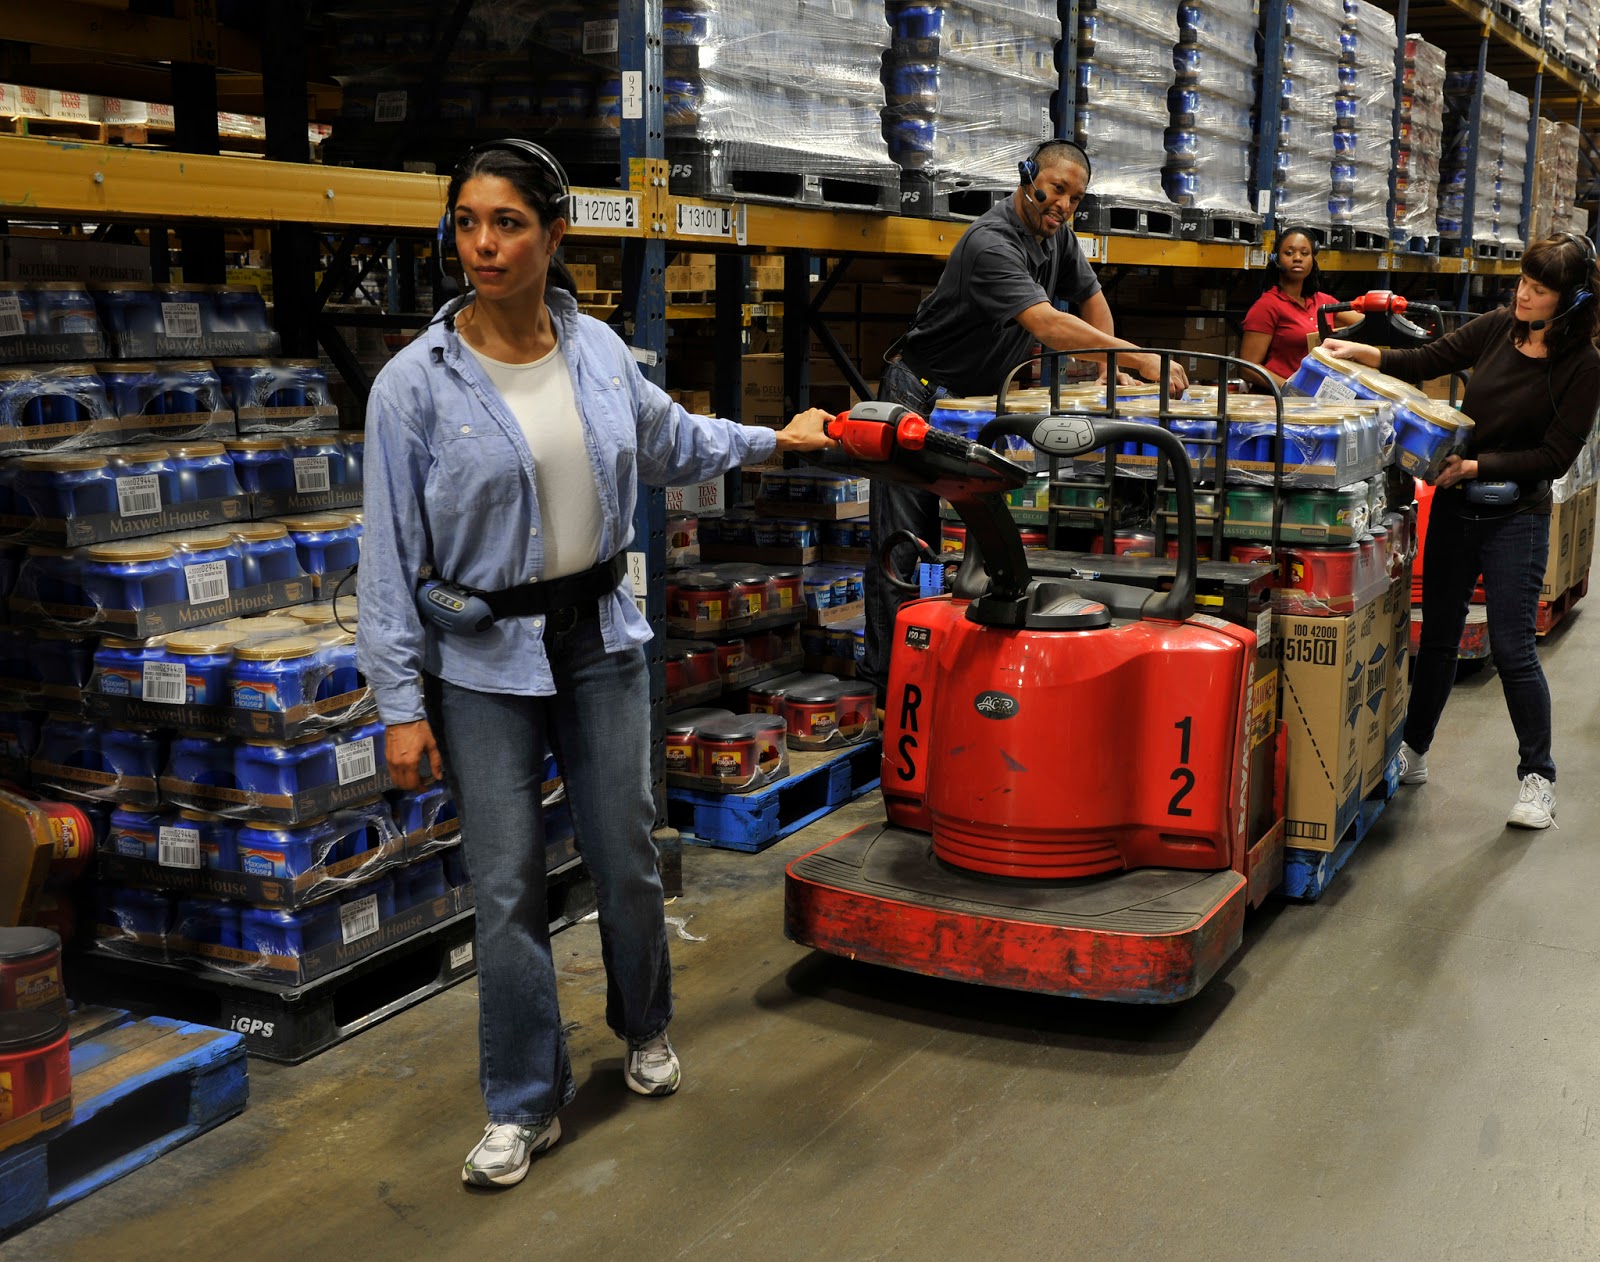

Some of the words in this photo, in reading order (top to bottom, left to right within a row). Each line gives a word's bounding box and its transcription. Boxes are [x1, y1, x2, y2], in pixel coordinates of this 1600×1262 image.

[61, 100, 81, 109] TOAST
[57, 111, 87, 119] CROUTONS
[584, 200, 621, 222] 12705
[688, 208, 717, 228] 13101
[18, 263, 79, 278] ROTHBURY
[288, 490, 334, 509] Maxwell
[336, 490, 363, 504] Hous
[666, 490, 683, 502] EXAS
[698, 484, 718, 498] TEXAS
[698, 495, 718, 508] TOAST
[110, 511, 168, 535] Maxwell
[170, 508, 211, 525] House
[178, 599, 233, 624] Maxwell
[235, 594, 275, 613] House
[1294, 624, 1308, 637] 100
[1311, 625, 1337, 639] 42000
[100, 678, 129, 689] Maxwell
[101, 686, 126, 695] House
[233, 692, 263, 702] Maxwell
[234, 699, 260, 708] House
[127, 702, 185, 724] Maxwell
[188, 711, 237, 729] House
[716, 758, 736, 766] Folgers
[330, 774, 381, 804] Maxwell
[117, 840, 145, 850] Maxwell
[118, 847, 141, 856] House
[244, 858, 272, 869] Maxwell
[245, 866, 268, 875] House
[203, 876, 247, 896] House
[335, 928, 385, 962] Maxwell
[387, 914, 423, 938] House
[25, 981, 53, 996] Folgers
[230, 1014, 275, 1038] iGPS
